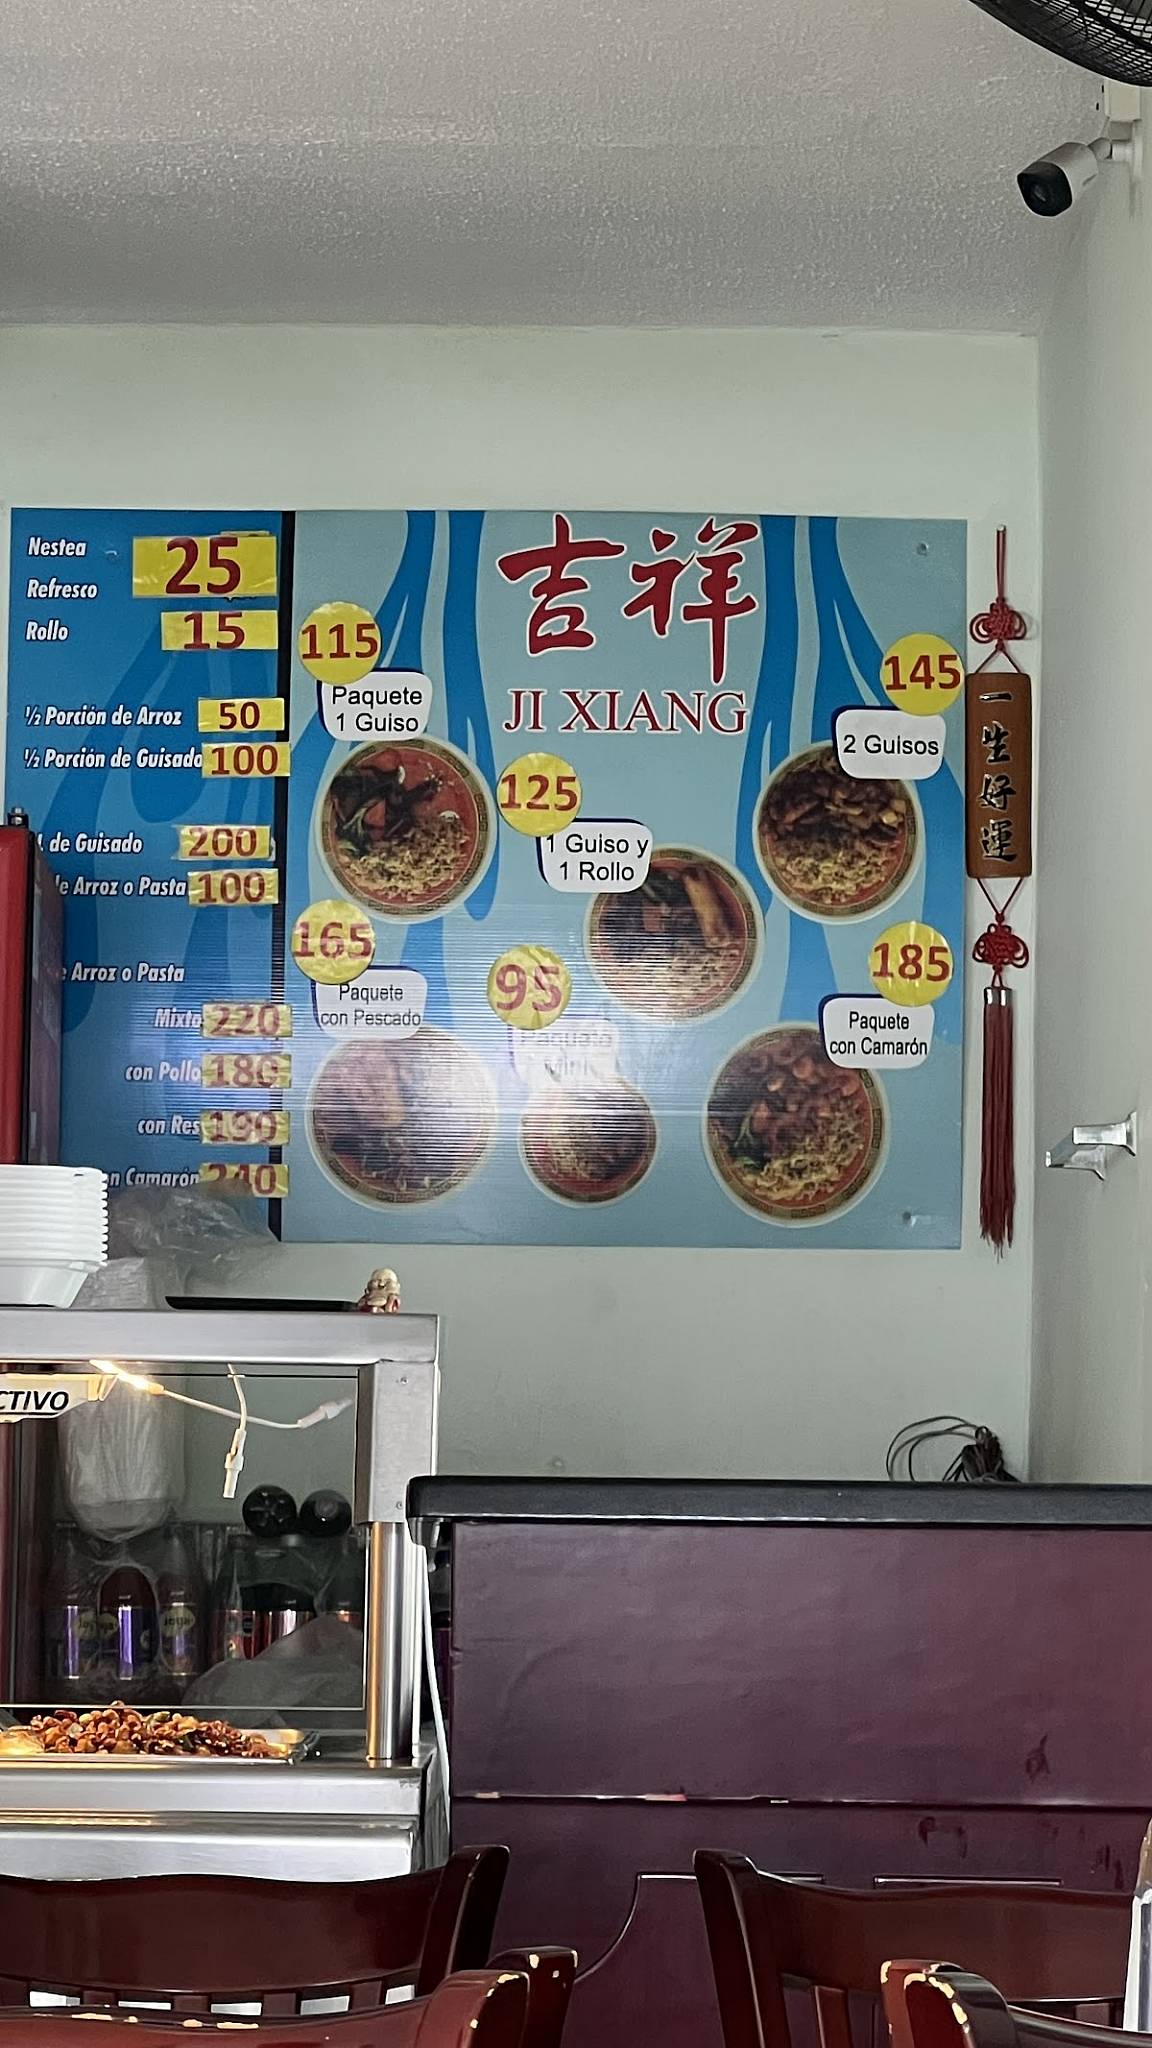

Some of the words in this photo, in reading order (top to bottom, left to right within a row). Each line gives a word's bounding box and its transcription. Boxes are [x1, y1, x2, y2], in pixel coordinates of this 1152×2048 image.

[28, 537, 87, 557] Nestea
[165, 536, 242, 595] 25
[27, 578, 98, 599] Refresco
[498, 514, 758, 685] 吉祥
[26, 620, 69, 641] Rollo
[183, 612, 246, 650] 15
[301, 624, 378, 660] 115
[884, 655, 961, 690] 145
[332, 685, 424, 708] Paquete
[45, 704, 106, 725] Porción
[111, 704, 132, 725] de
[136, 706, 182, 725] Arroz
[219, 701, 260, 730] 50
[336, 713, 346, 731] 1
[355, 713, 419, 732] Guiso
[504, 690, 543, 730] JI
[561, 690, 747, 733] XIANG
[44, 747, 105, 768] Porción
[110, 746, 131, 768] de
[136, 747, 203, 768] Guisado
[843, 735, 857, 754] 2
[864, 734, 939, 756] Guisos
[211, 744, 278, 775] 100
[978, 692, 1017, 862] 一生好運
[500, 774, 578, 811] 125
[49, 832, 70, 852] de
[75, 832, 143, 853] Guisado
[188, 827, 257, 856] 200
[546, 835, 555, 853] 1
[565, 834, 630, 853] Guiso
[637, 837, 649, 858] y
[559, 862, 569, 880] 1
[579, 862, 635, 881] Rollo
[73, 876, 119, 895] Arroz
[123, 881, 132, 896] o
[138, 877, 186, 896] Pasta
[198, 872, 266, 903] 100
[294, 922, 372, 958] 165
[71, 962, 117, 981] Arroz
[122, 968, 132, 981] o
[137, 963, 184, 982] Pasta
[872, 942, 950, 982] 185
[339, 984, 404, 1008] Paquete
[495, 964, 562, 1012] 95
[210, 1005, 280, 1035] 220
[321, 1012, 348, 1026] con
[354, 1010, 421, 1027] Pescado
[849, 1011, 910, 1034] Paquete
[830, 1040, 856, 1054] con
[861, 1037, 928, 1055] Camarón
[126, 1067, 153, 1081] con
[159, 1060, 201, 1081] Pollo
[210, 1056, 278, 1086] 180
[138, 1119, 165, 1134] con
[171, 1115, 200, 1135] Res
[210, 1112, 277, 1142] 190
[126, 1167, 199, 1187] Camarón
